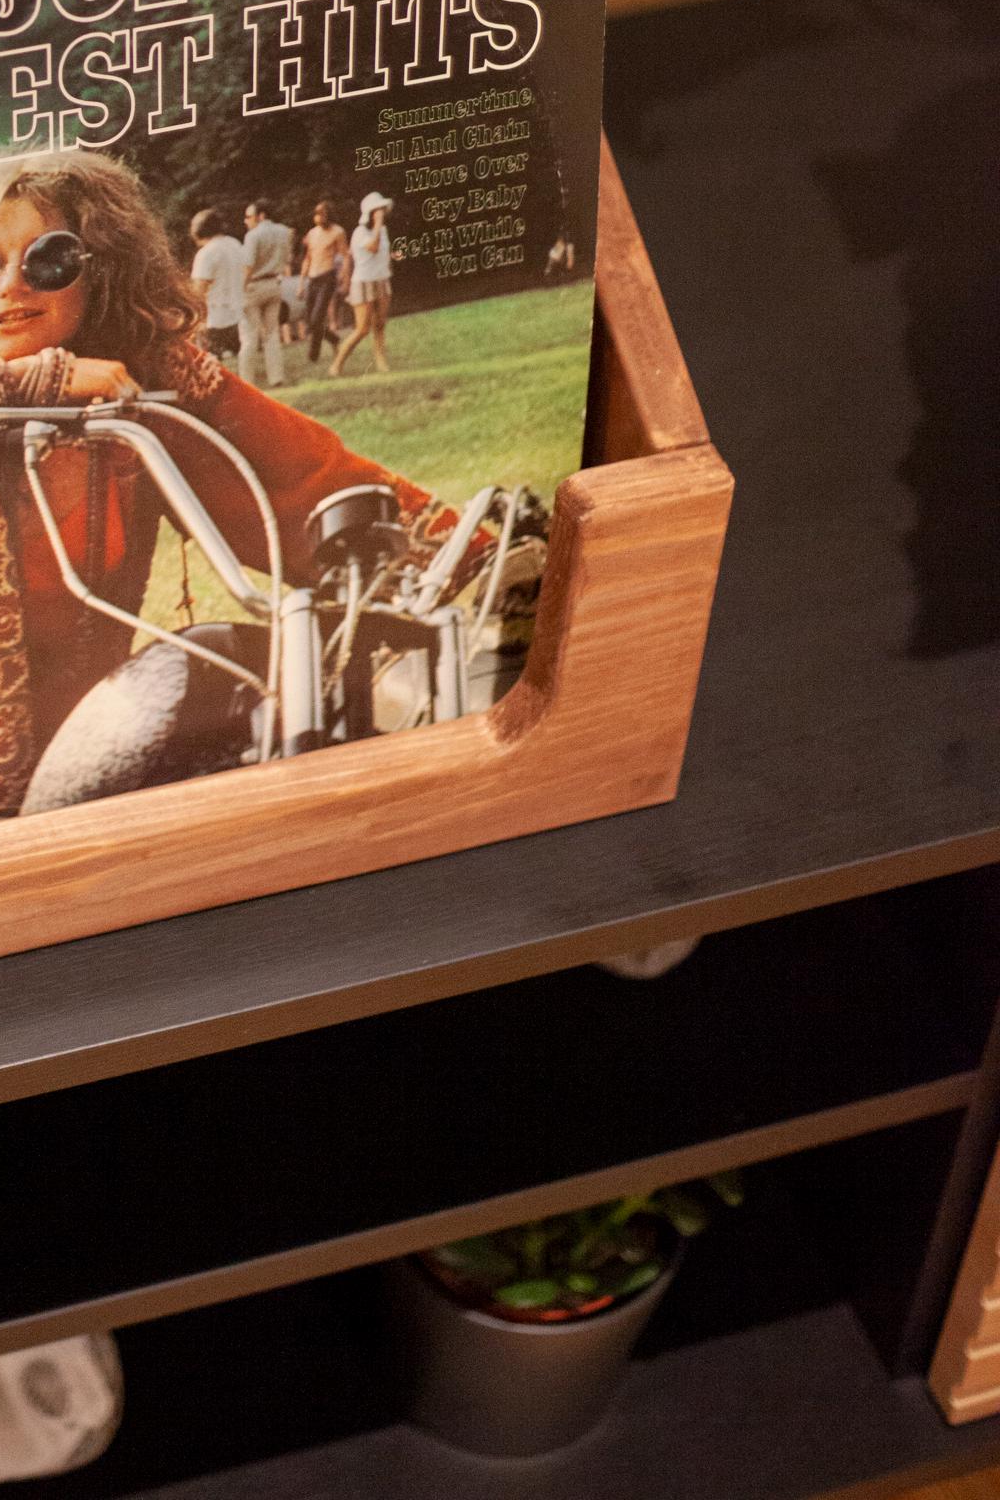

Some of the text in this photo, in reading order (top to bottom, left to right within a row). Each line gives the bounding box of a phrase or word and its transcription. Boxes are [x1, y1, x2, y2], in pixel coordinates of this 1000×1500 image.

[354, 118, 530, 171] Ball And Chain
[405, 152, 530, 193] Move Over
[421, 183, 528, 222] Cry Baby
[391, 215, 526, 261] Get It While
[435, 244, 525, 279] You Can
